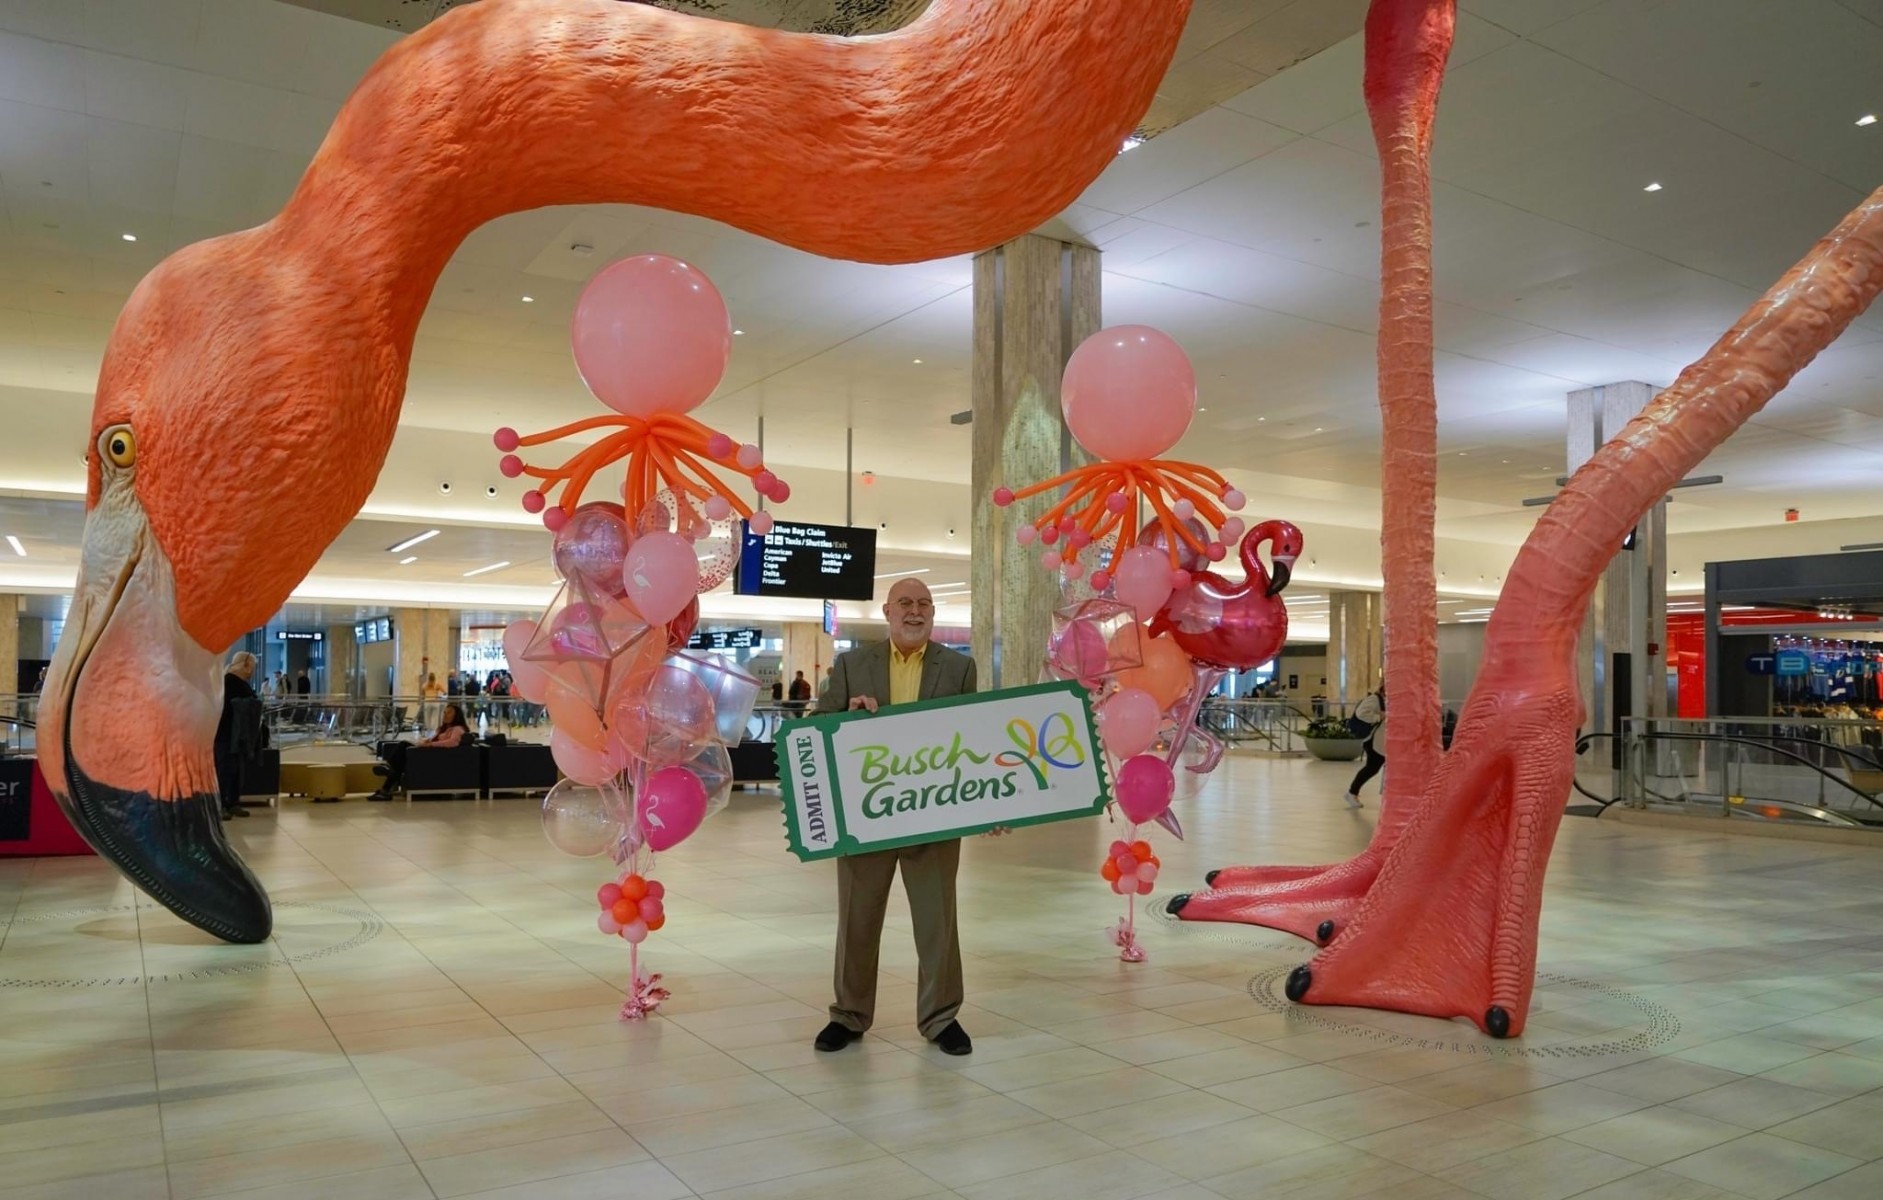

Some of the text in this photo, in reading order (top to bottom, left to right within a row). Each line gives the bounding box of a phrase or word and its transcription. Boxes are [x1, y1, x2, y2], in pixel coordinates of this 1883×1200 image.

[775, 525, 826, 537] Blue Bag Claim
[764, 547, 793, 556] American
[763, 554, 787, 563] Cayman
[842, 552, 852, 561] Air
[763, 562, 779, 570] Copa
[821, 566, 841, 574] United
[763, 570, 780, 578] Delta
[762, 577, 786, 586] Frontier
[849, 731, 991, 784] Busch
[796, 735, 828, 844] ADMIT ONE
[861, 766, 1018, 819] Gardens
